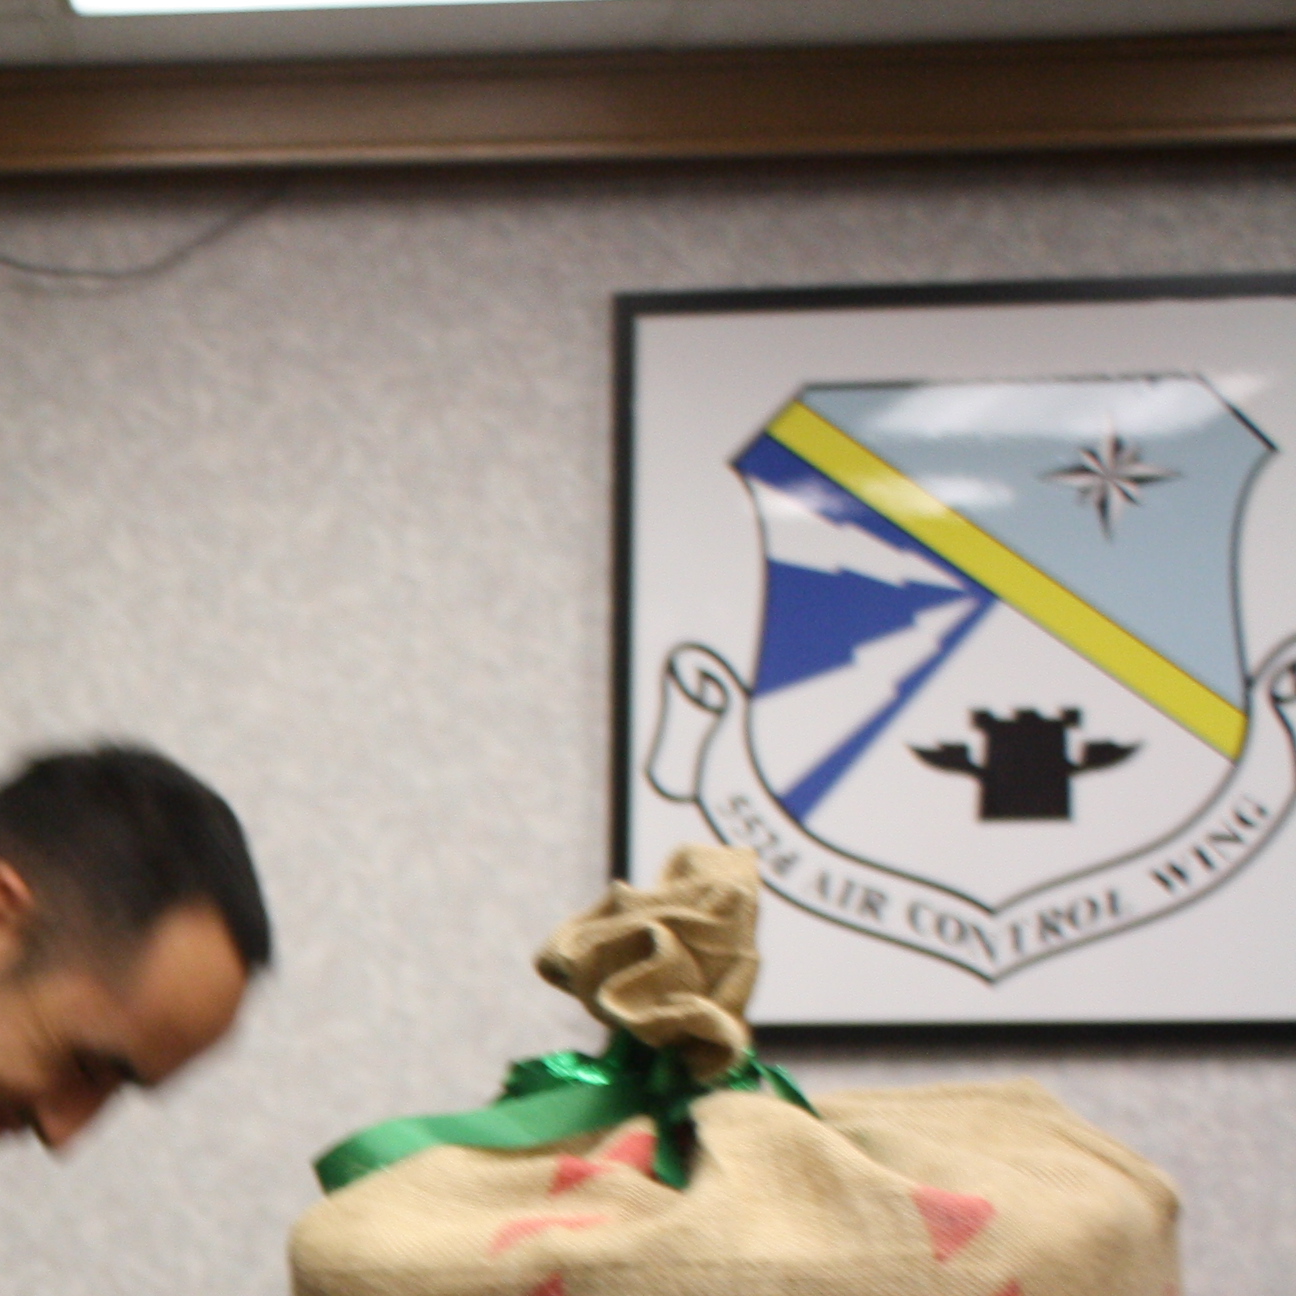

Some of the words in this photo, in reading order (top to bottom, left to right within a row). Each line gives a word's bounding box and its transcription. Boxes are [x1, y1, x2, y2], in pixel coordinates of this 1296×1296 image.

[808, 868, 890, 922] AIR
[906, 885, 1132, 964] CONTROL
[1148, 796, 1270, 894] WING
